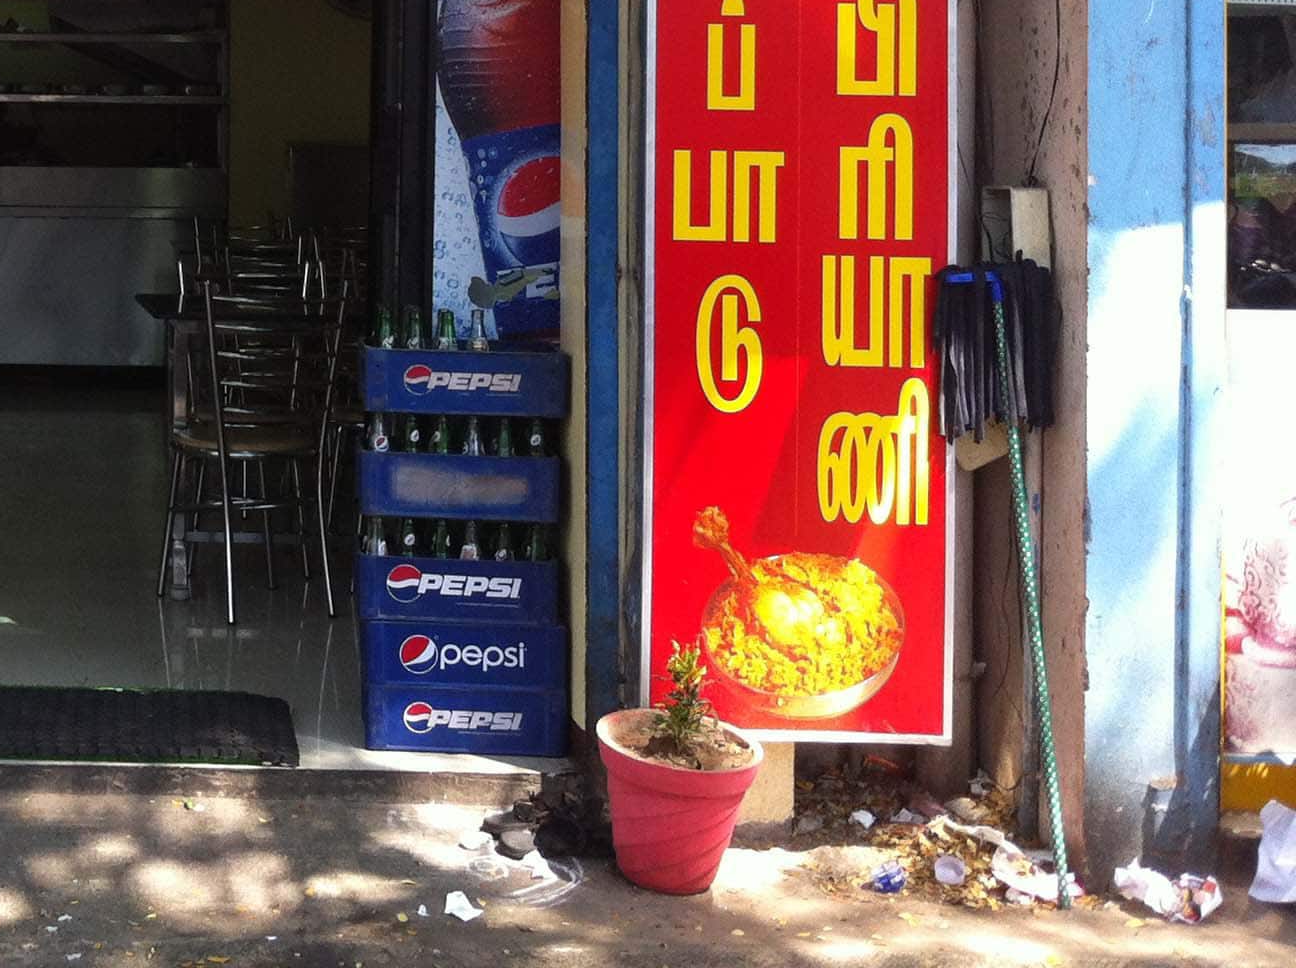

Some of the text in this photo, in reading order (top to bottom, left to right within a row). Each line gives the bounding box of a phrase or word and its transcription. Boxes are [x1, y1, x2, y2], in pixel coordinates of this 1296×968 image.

[427, 371, 522, 392] PEPSI
[418, 574, 520, 598] PEPSI
[439, 641, 526, 672] pepsi
[426, 708, 522, 730] PEPSI
